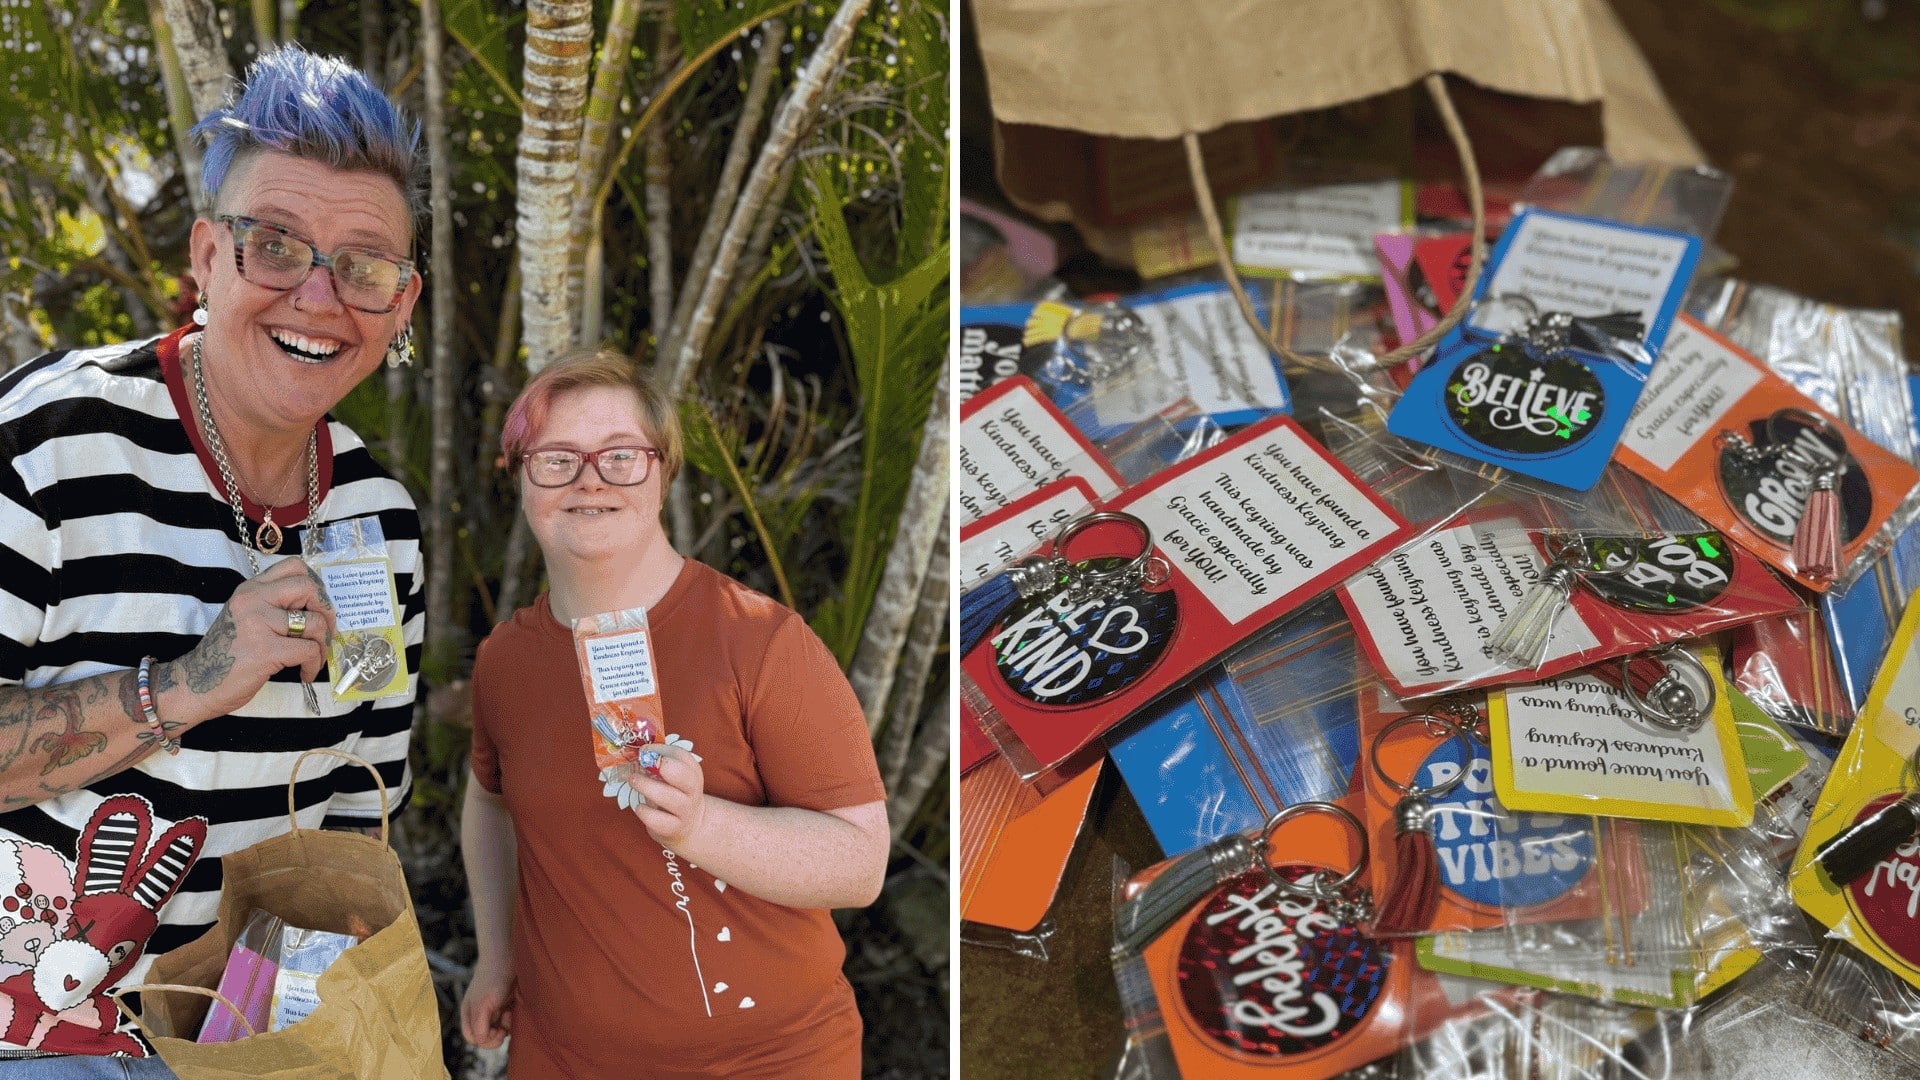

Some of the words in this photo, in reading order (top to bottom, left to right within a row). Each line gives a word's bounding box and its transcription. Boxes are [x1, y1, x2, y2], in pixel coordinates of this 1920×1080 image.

[980, 419, 1038, 480] Kindness
[1001, 408, 1031, 438] You
[1029, 435, 1067, 471] have
[1243, 452, 1298, 505] Kindness
[1295, 501, 1346, 550] Keyring
[1263, 443, 1291, 469] You
[1289, 465, 1322, 497] have
[1316, 494, 1360, 530] found
[1356, 528, 1370, 540] a
[1167, 495, 1211, 537] Gracie
[1206, 534, 1268, 595] especially
[1198, 490, 1266, 557] handmade
[1262, 553, 1283, 575] by
[1214, 471, 1242, 500] This
[1238, 498, 1286, 545] keyring
[1284, 541, 1314, 569] was
[1163, 529, 1189, 553] for
[1184, 545, 1228, 584] YOU!
[1393, 552, 1429, 606] Keyring
[1429, 539, 1452, 568] was
[1459, 543, 1477, 563] by
[1479, 532, 1524, 598] especially
[1366, 566, 1405, 609] found
[1447, 570, 1484, 624] keyring
[1470, 564, 1509, 623] ndmade
[990, 606, 1092, 697] KIND
[1392, 608, 1418, 648] have
[1421, 603, 1464, 673] Kindness
[1413, 646, 1441, 677] You
[1519, 695, 1562, 708] was
[1564, 698, 1644, 723] keyring
[1521, 755, 1539, 768] a
[1525, 727, 1609, 754] Keyring
[1542, 756, 1607, 775] found
[1610, 739, 1705, 763] Kindness
[1610, 761, 1664, 782] have
[1668, 767, 1711, 786] You
[662, 846, 690, 913] ower
[1437, 833, 1580, 885] VIBES
[1206, 883, 1341, 1037] Happy
